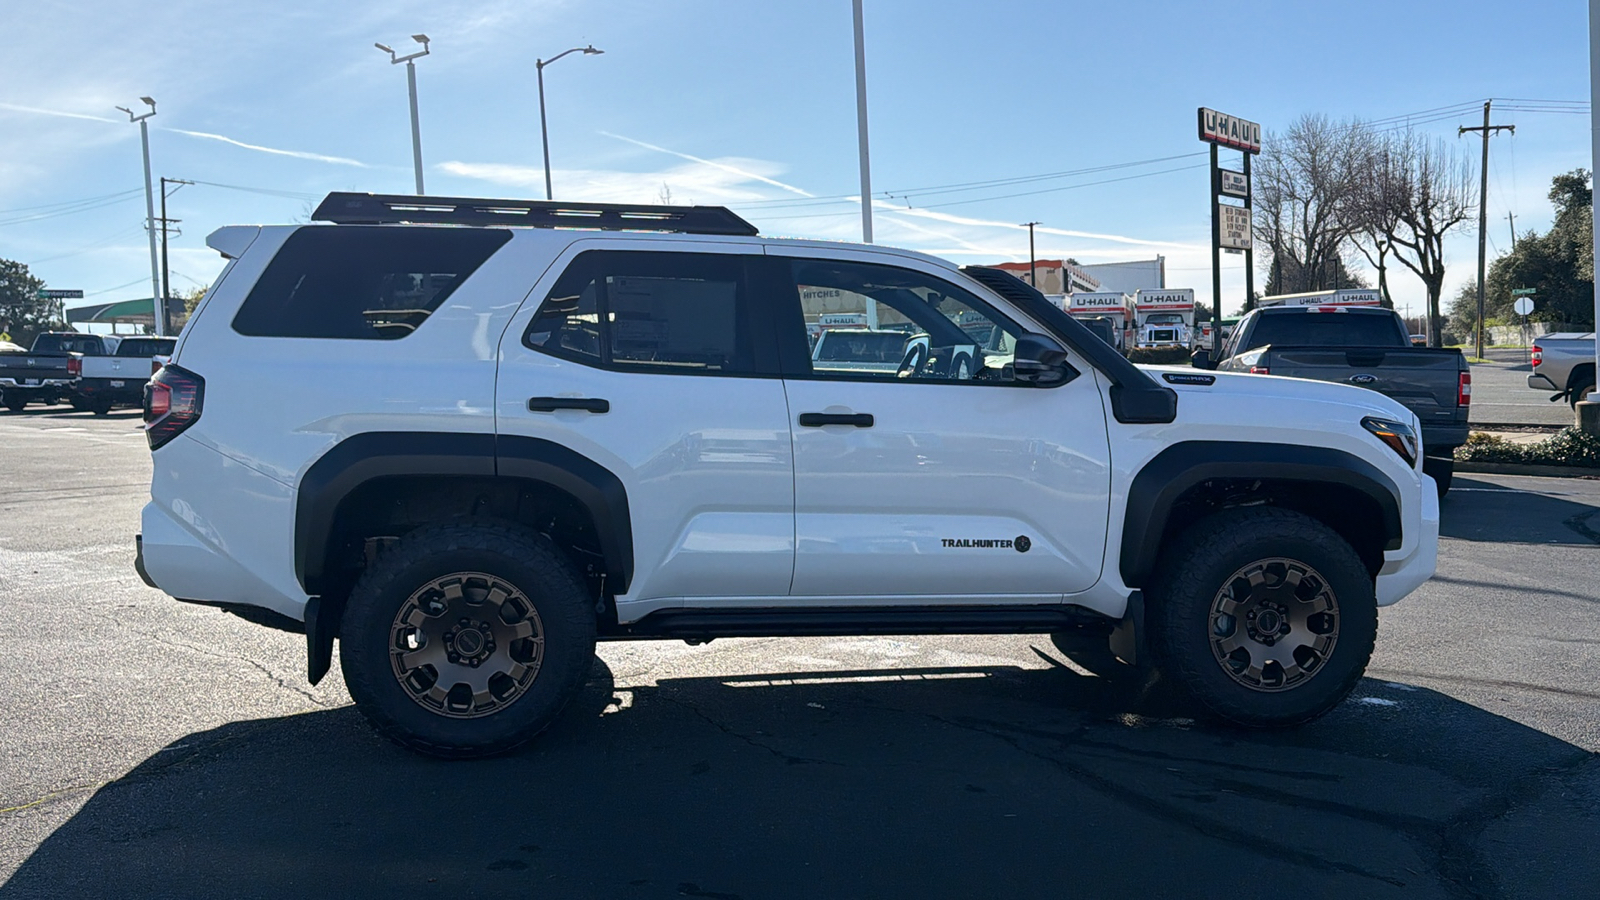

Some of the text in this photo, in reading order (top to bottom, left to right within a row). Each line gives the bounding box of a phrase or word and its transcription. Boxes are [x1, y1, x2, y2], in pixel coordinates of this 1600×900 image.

[803, 290, 840, 299] HITCHES
[1342, 294, 1375, 302] U-HAUL
[1077, 298, 1118, 306] U-HAUL
[1144, 295, 1188, 303] U-HAUL
[1299, 297, 1322, 305] U-HAUL
[941, 539, 1013, 548] TRAILHUNTER
